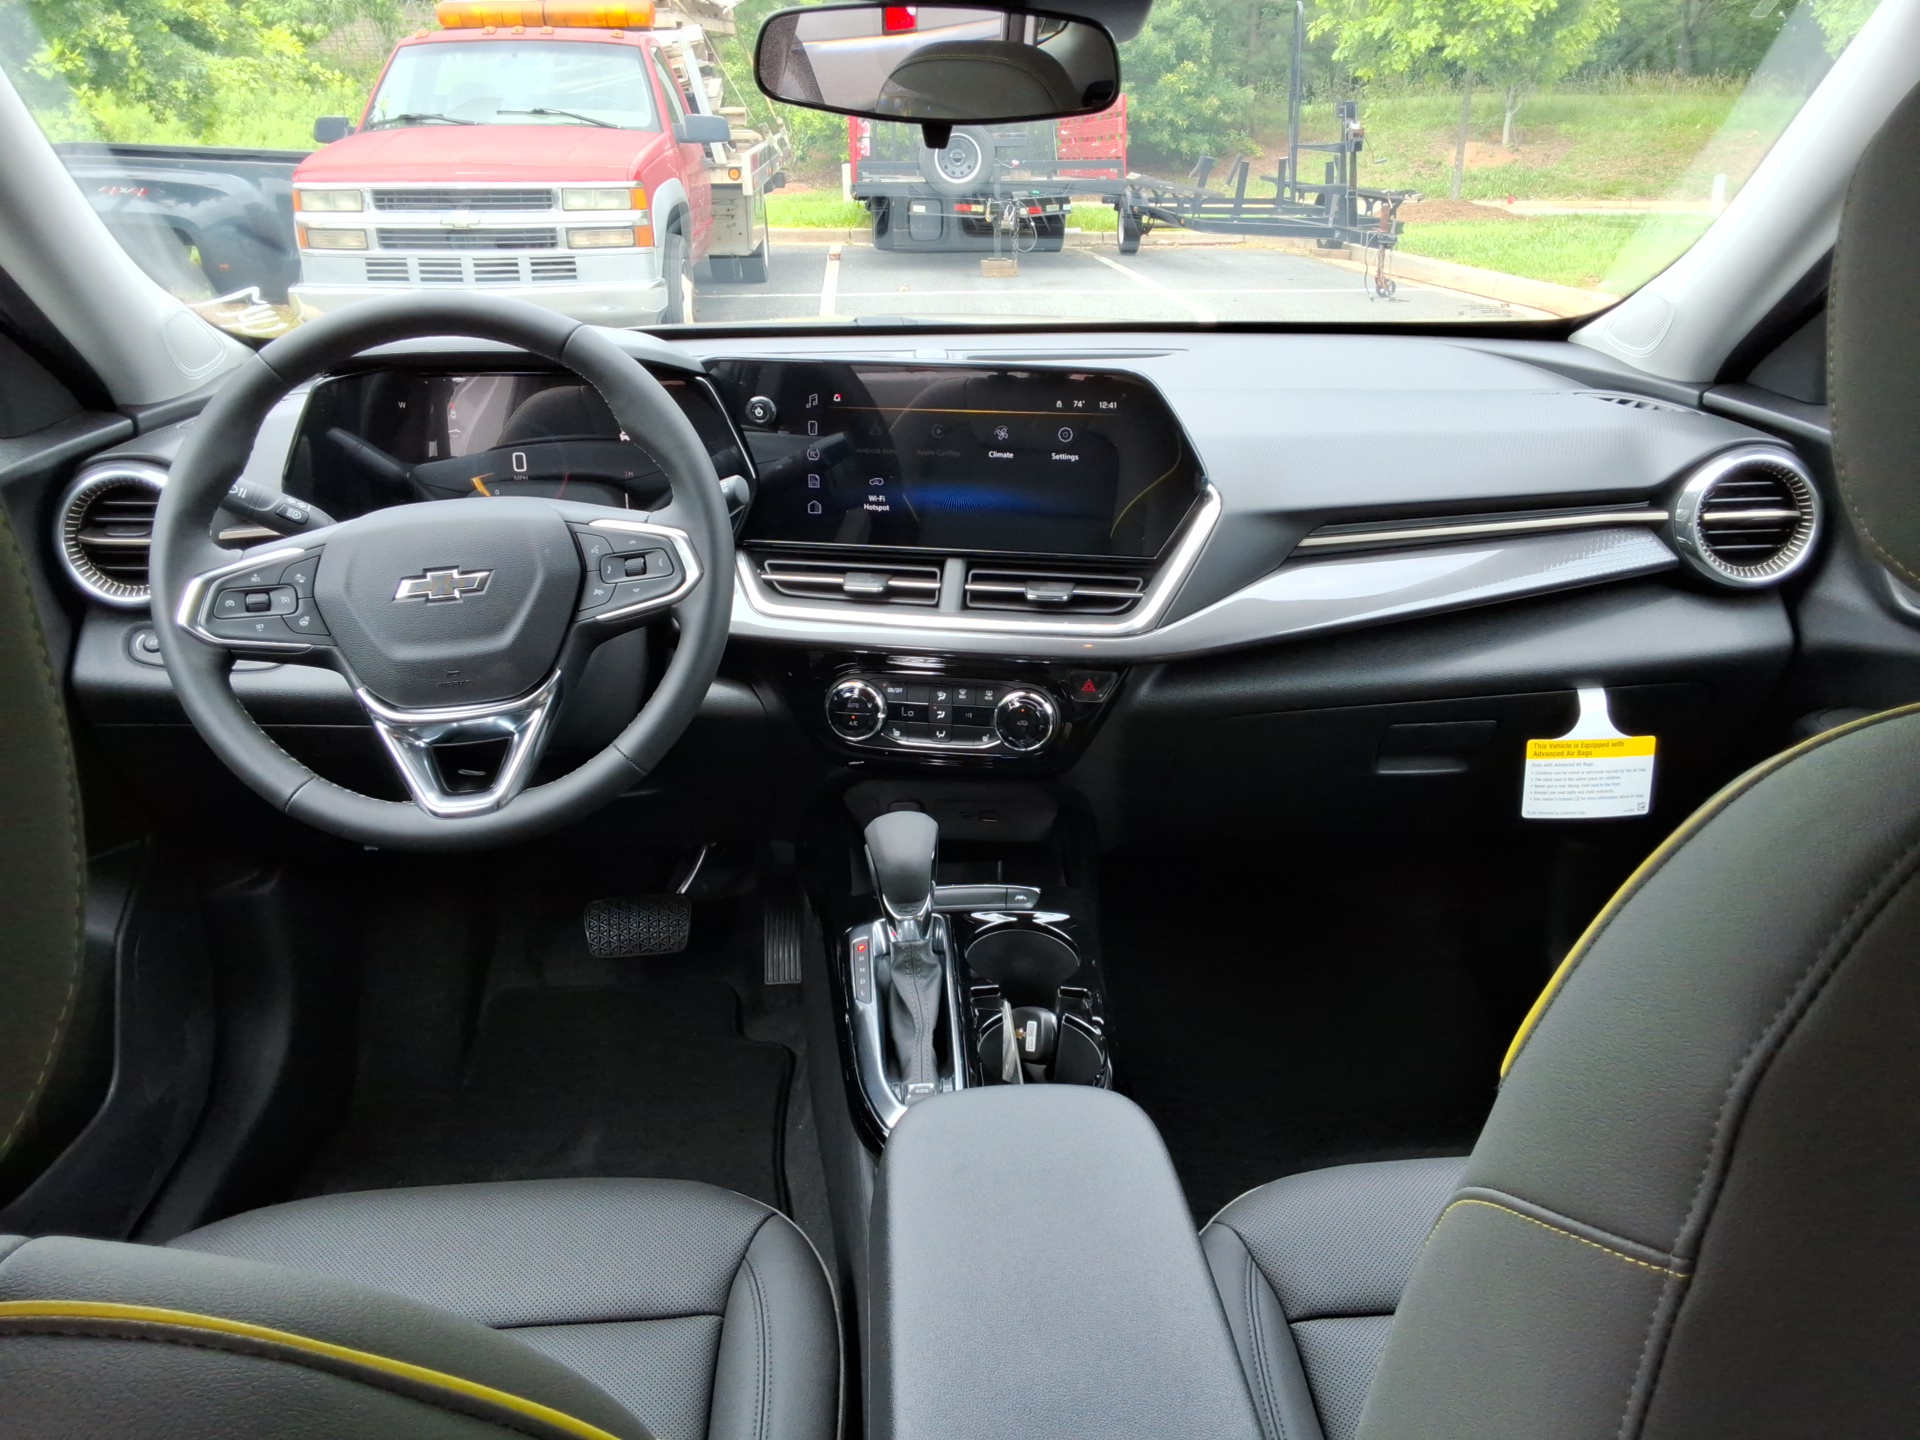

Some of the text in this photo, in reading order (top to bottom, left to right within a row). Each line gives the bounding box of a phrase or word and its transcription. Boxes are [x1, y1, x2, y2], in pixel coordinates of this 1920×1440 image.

[1099, 401, 1117, 409] 12:41
[988, 451, 1014, 459] Climate
[1051, 452, 1079, 462] Settings
[512, 452, 527, 472] 0
[863, 503, 889, 512] Hotspot
[1581, 741, 1610, 749] Equipped
